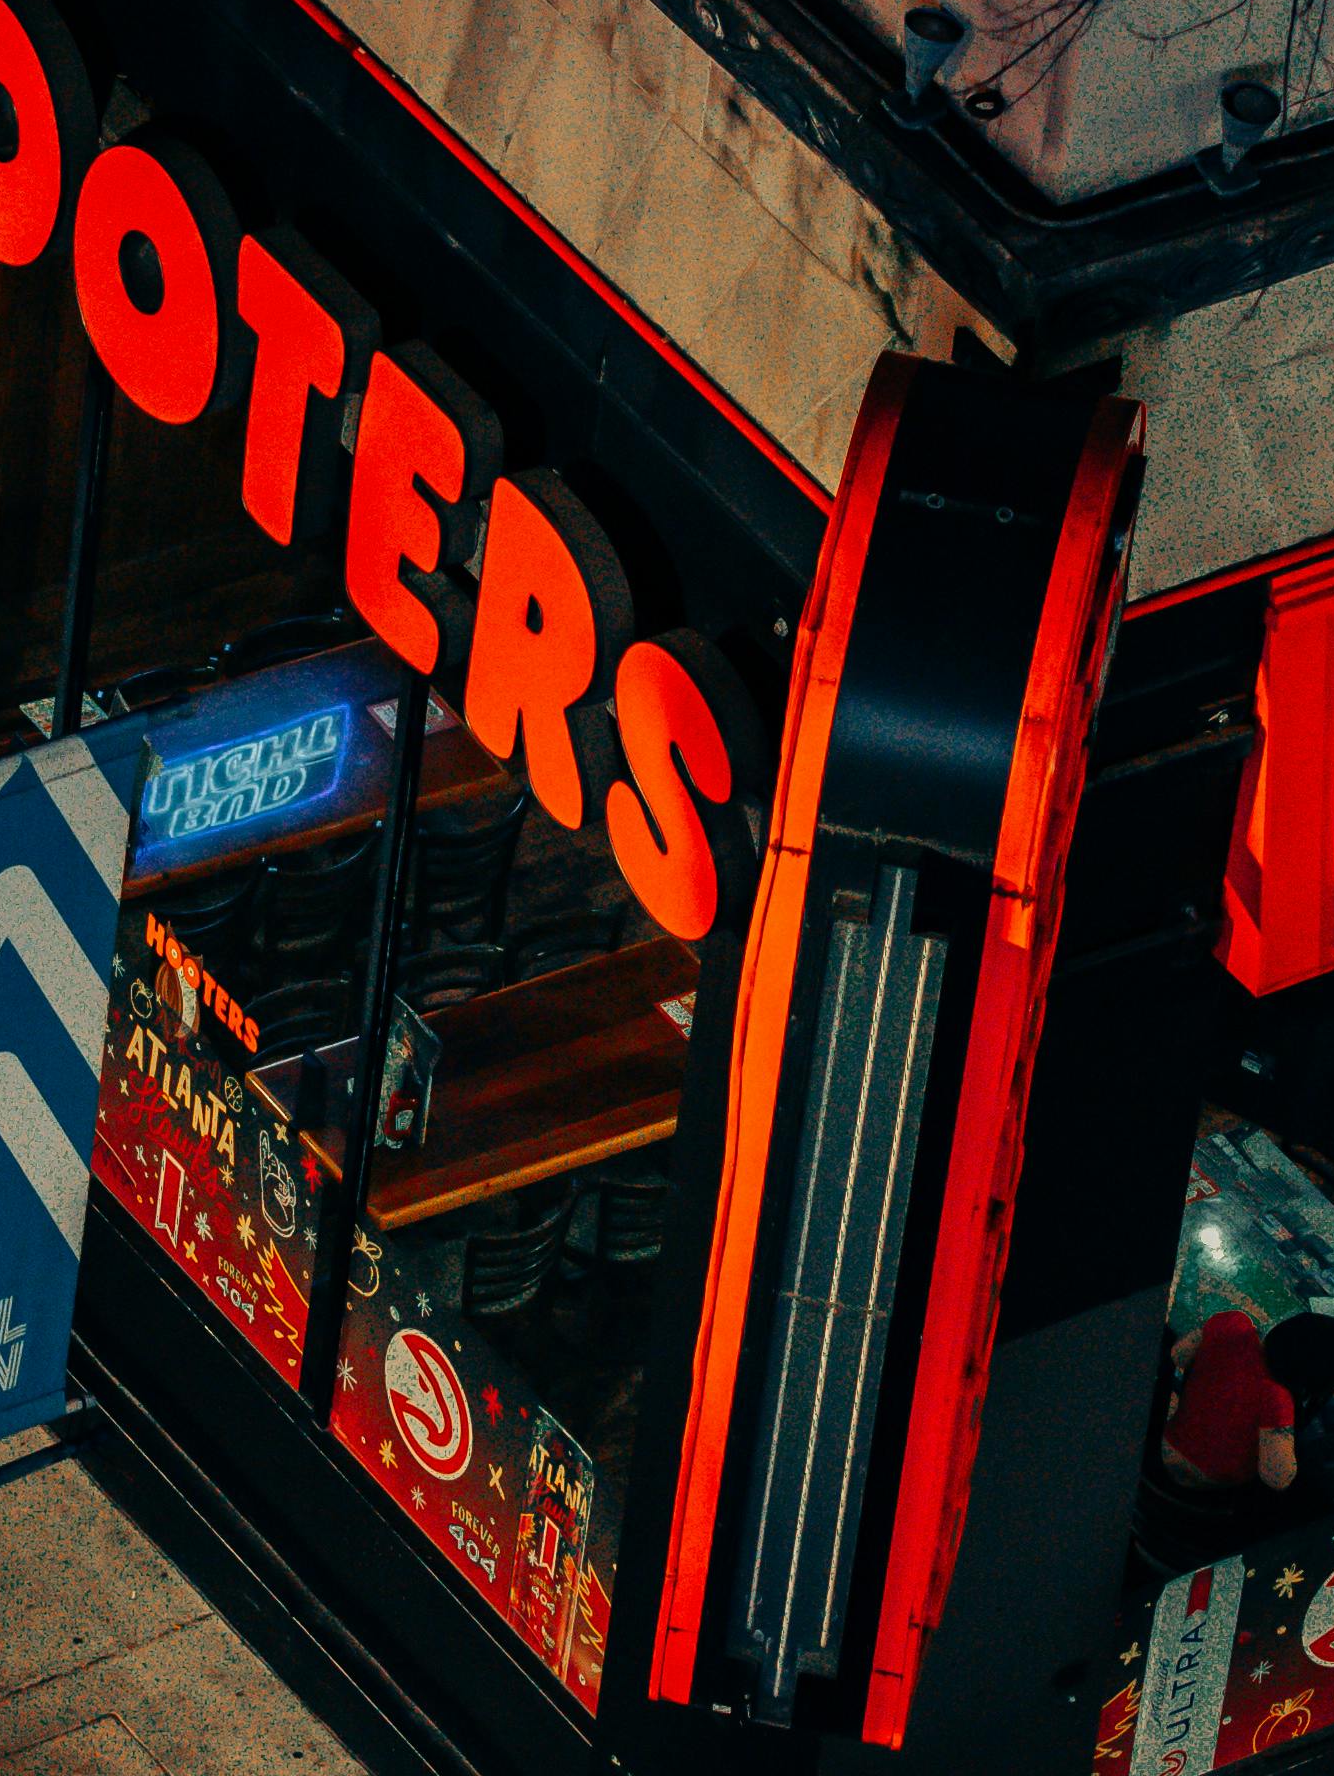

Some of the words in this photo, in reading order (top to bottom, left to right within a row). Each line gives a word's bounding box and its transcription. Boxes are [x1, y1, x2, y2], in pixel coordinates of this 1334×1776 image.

[146, 912, 261, 1053] HOOTERS
[125, 1023, 235, 1166] ATLANTA
[215, 1275, 255, 1324] 404
[217, 1256, 259, 1304] FOREVER
[528, 1442, 588, 1518] ATLANTA
[447, 1523, 498, 1584] 404
[450, 1499, 502, 1559] FOREVER
[1163, 1620, 1208, 1746] ULTRA
